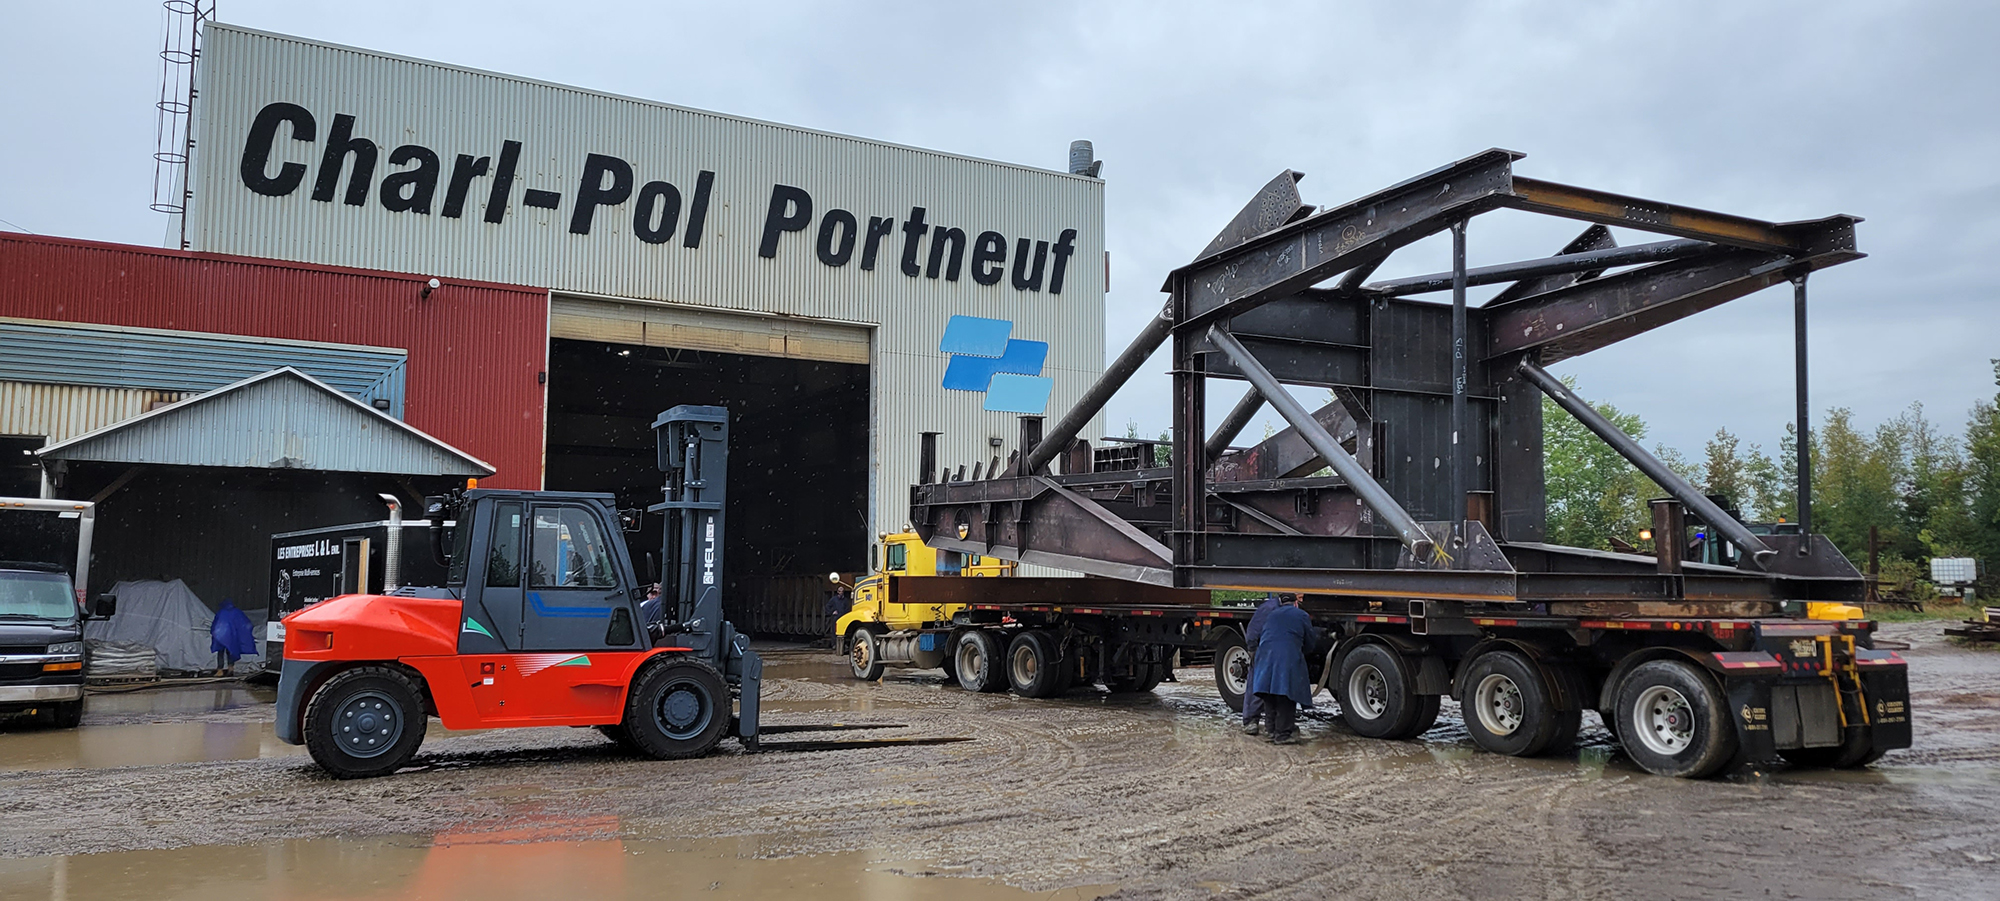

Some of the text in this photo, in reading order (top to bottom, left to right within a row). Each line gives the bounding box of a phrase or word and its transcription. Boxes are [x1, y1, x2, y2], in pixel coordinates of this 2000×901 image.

[240, 103, 1078, 295] Charl-Pol Portneuf
[277, 547, 286, 560] LES
[285, 544, 315, 559] ENTREPRISES
[315, 540, 319, 557] L
[320, 540, 325, 557] &
[326, 539, 330, 556] L
[704, 537, 714, 576] HELI
